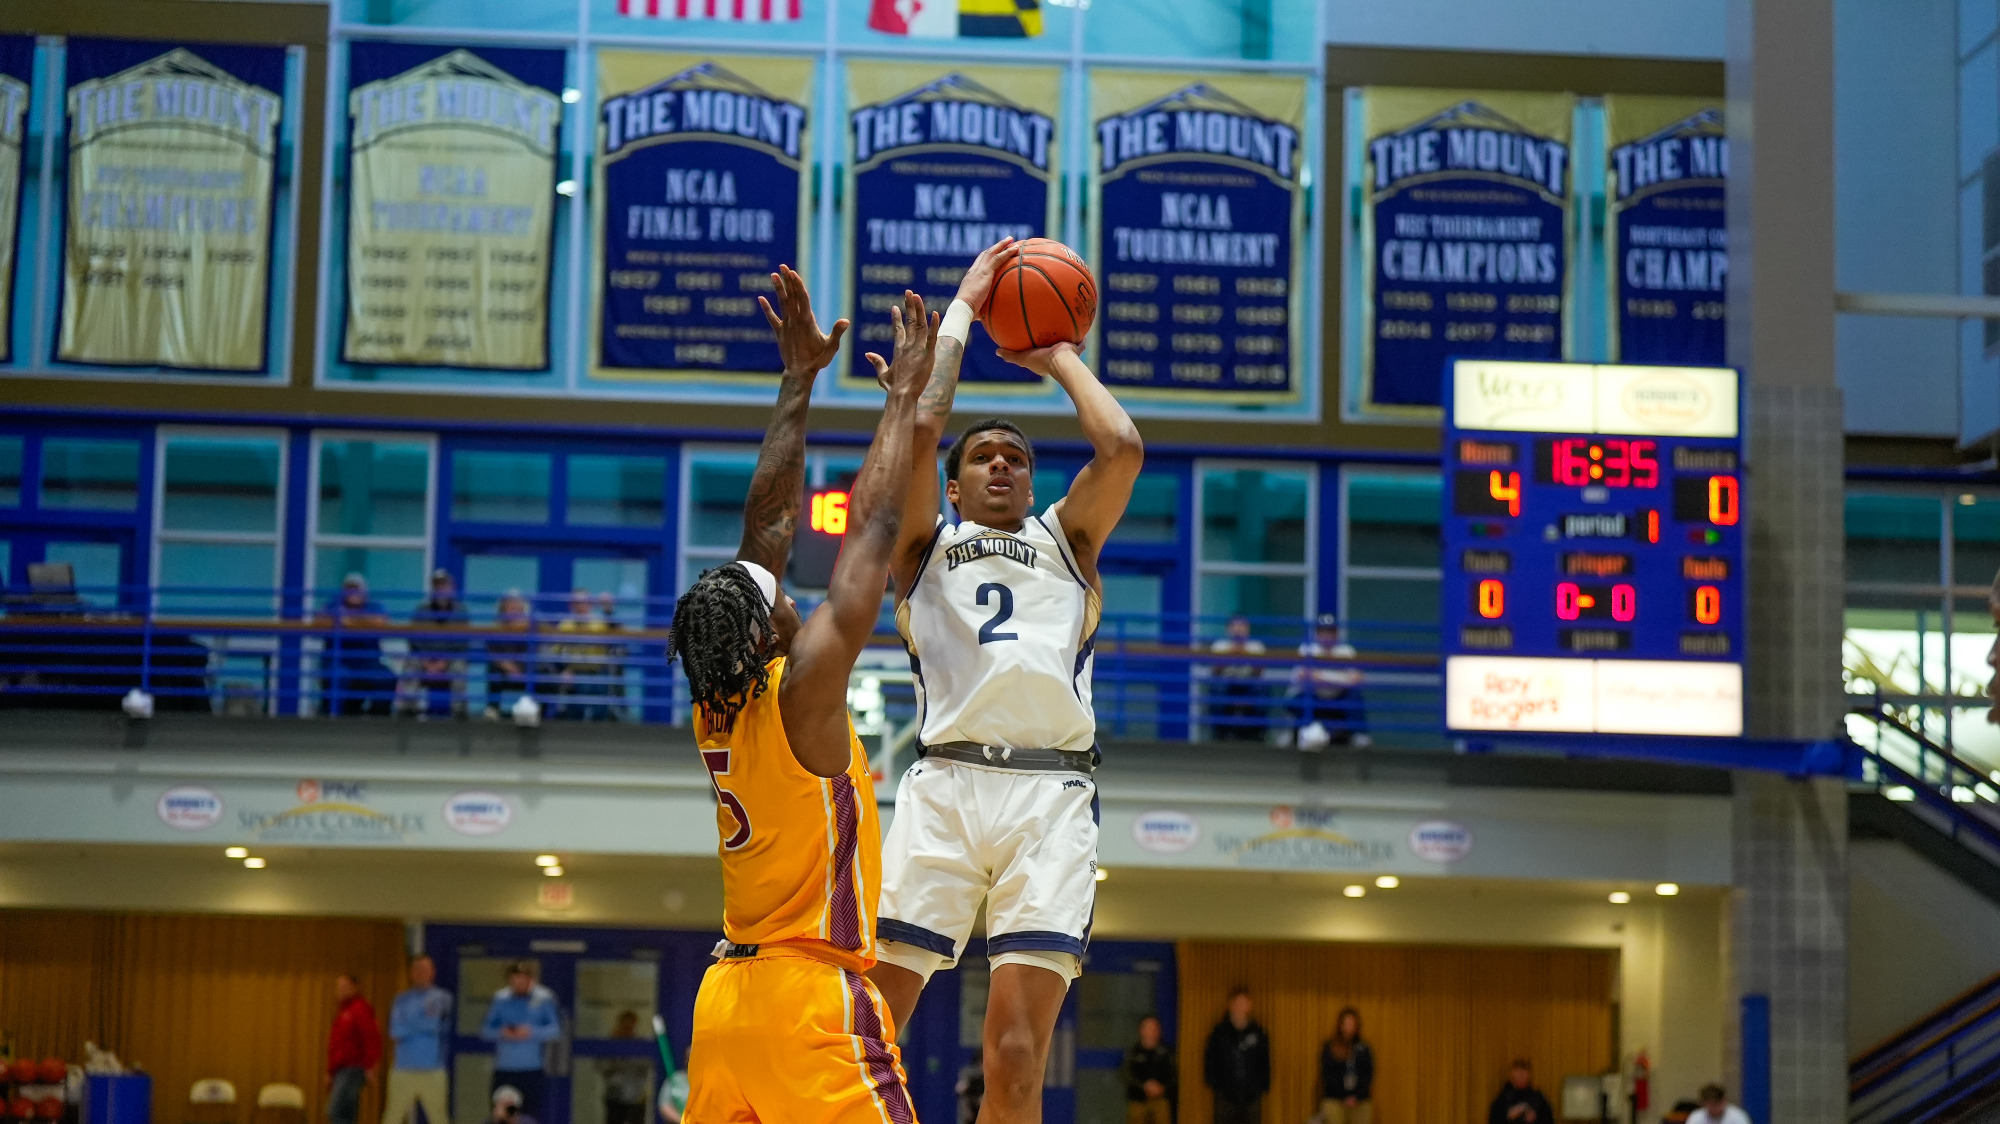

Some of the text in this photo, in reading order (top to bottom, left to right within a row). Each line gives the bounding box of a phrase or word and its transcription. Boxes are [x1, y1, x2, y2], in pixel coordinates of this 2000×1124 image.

[77, 82, 143, 136] THE
[156, 81, 273, 143] MOUNT
[360, 82, 554, 144] THE MOUNT
[604, 91, 804, 158] THE MOUNT
[854, 101, 1052, 168] THE MOUNT
[1102, 111, 1298, 177] THE MOUNT
[1372, 130, 1568, 193] THE MOUNT
[1613, 138, 1682, 197] THE
[666, 169, 736, 205] NCAA
[914, 183, 986, 220] NCAA
[627, 205, 774, 242] FINAL FOUR
[1161, 192, 1232, 230] NCAA
[1113, 227, 1279, 267] TOURNAMENT
[1382, 239, 1556, 283] CHAMPIONS
[1626, 248, 1729, 291] CHAMP
[1552, 439, 1658, 488] 16:35
[811, 490, 847, 534] 16
[1490, 470, 1520, 517] 4
[1709, 475, 1739, 525] 0
[1565, 509, 1659, 543] period 1
[947, 539, 1036, 569] THE MOUNT
[976, 583, 1018, 645] 2
[1479, 579, 1504, 618] 0
[1696, 585, 1720, 624] 0
[1485, 673, 1531, 695] Roy
[700, 748, 752, 851] 5
[1062, 780, 1087, 790] MAAC
